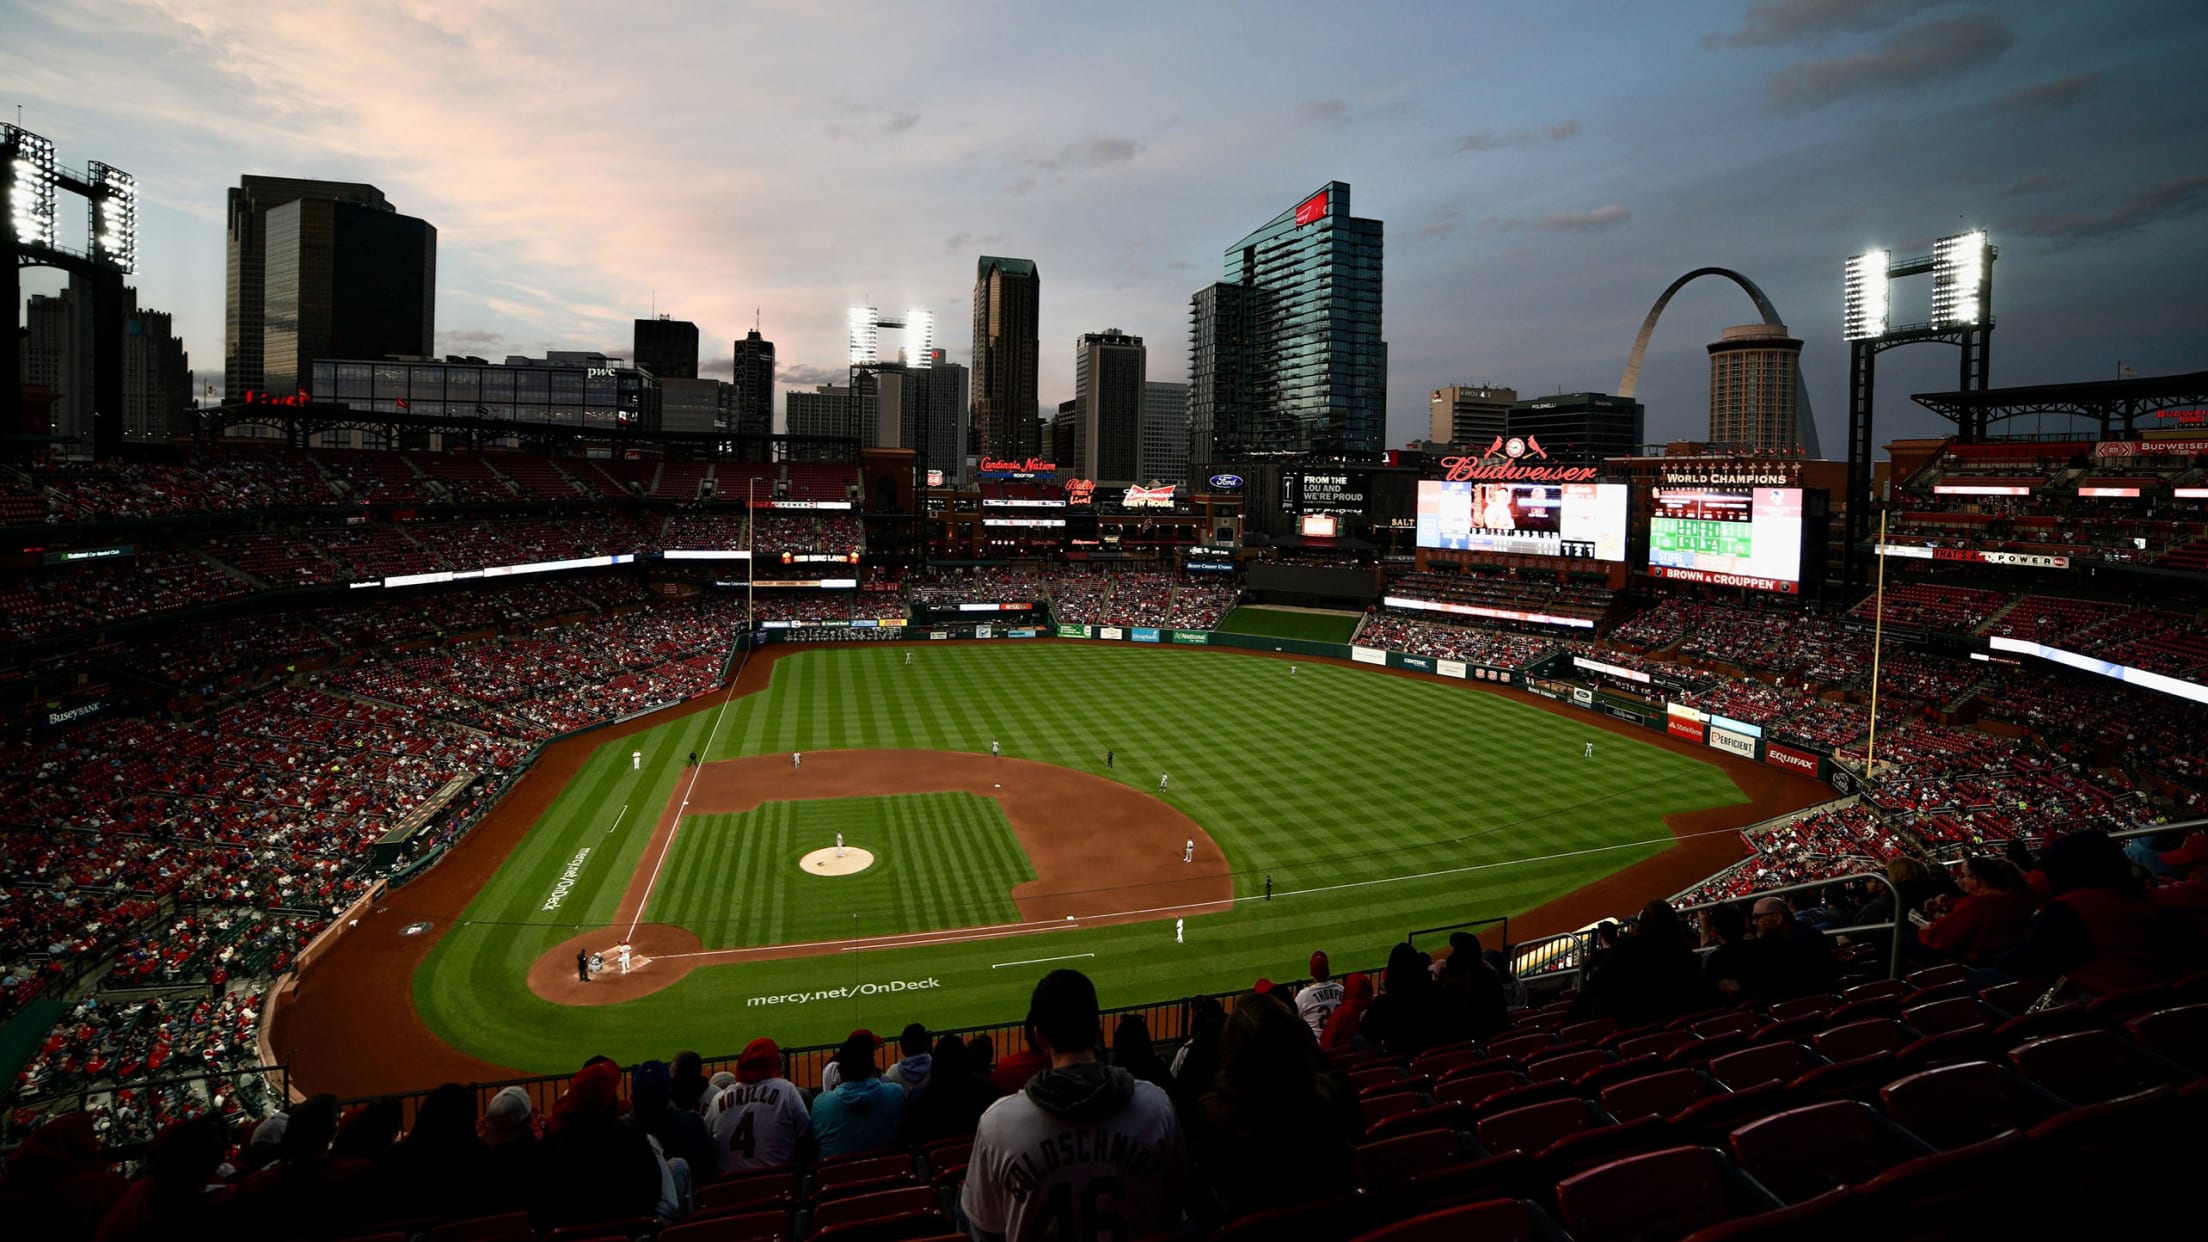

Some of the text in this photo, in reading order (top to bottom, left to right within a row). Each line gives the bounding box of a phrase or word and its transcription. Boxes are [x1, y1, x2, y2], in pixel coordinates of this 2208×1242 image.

[588, 367, 616, 379] pwc
[980, 456, 1056, 472] Cardinals Nation
[1441, 456, 1598, 481] Budweiser
[1216, 475, 1236, 487] Ford
[1303, 476, 1347, 485] FROM THE
[1666, 473, 1788, 485] WORLD CHAMPIONS
[1303, 484, 1341, 492] LOU AND
[1303, 492, 1364, 502] WE'RE PROUD
[1147, 500, 1175, 508] HOUSE
[1391, 518, 1415, 526] SALT
[1574, 547, 1582, 556] 2
[1933, 548, 1966, 560] THAT'S
[1998, 554, 2051, 565] POWER
[1666, 568, 1703, 582] BROWN
[1713, 574, 1775, 590] CROUPPEN
[1181, 632, 1207, 640] National
[1711, 731, 1752, 753] PERFICIENT
[1769, 750, 1813, 770] EQUIFAX
[542, 847, 591, 911] mercy.net/OnDeck
[747, 977, 942, 1007] mercy.net/OnDeck
[729, 1111, 755, 1159] 4
